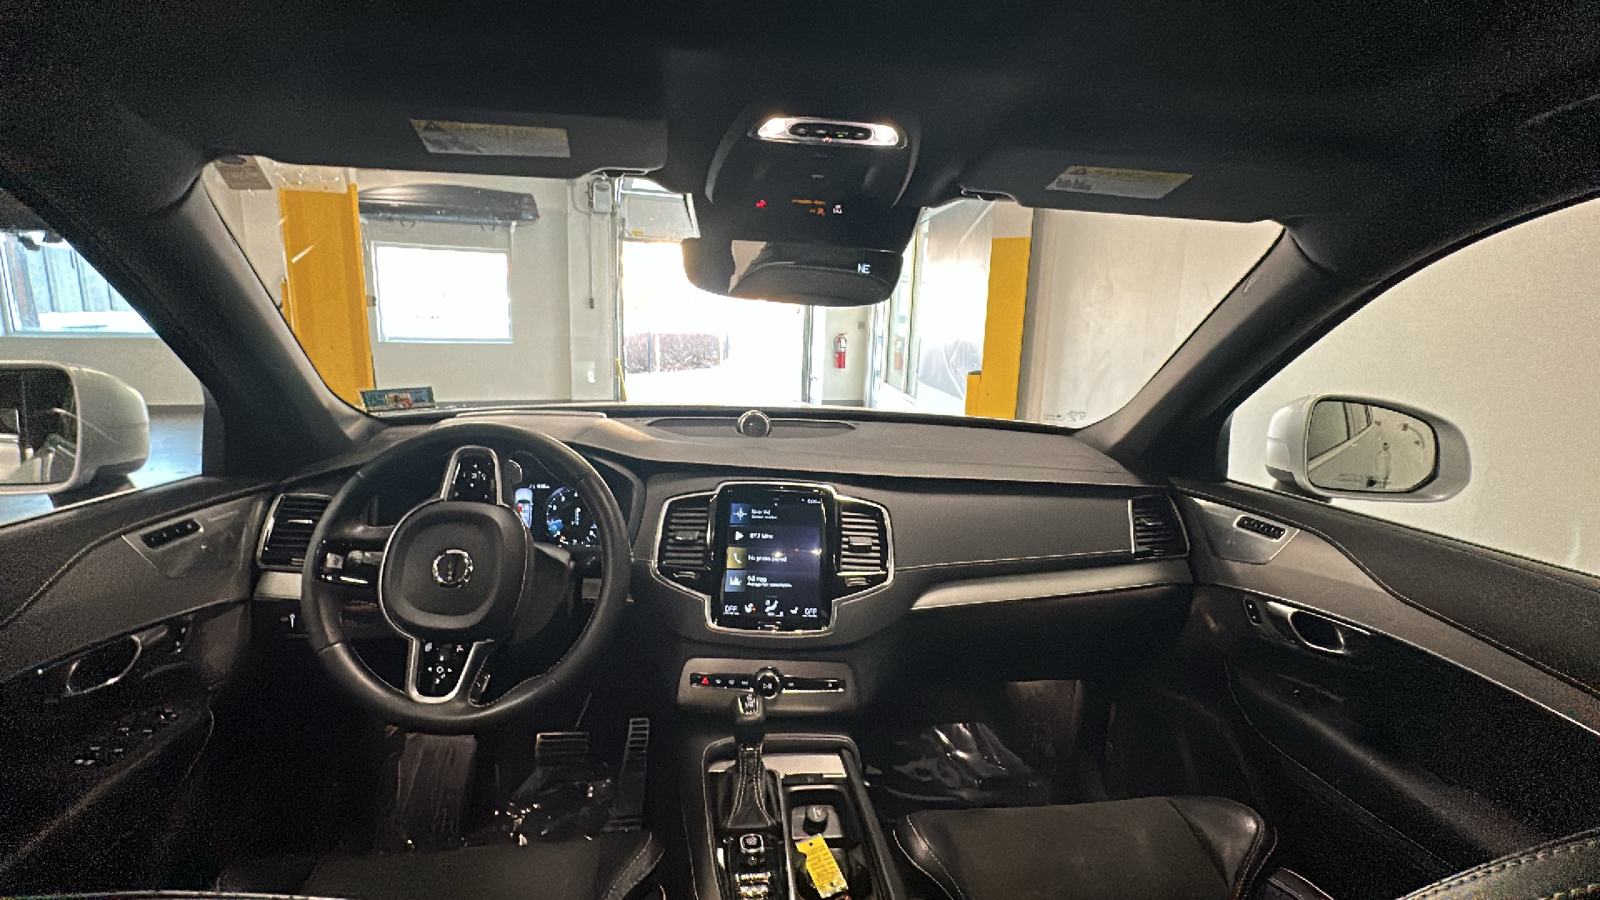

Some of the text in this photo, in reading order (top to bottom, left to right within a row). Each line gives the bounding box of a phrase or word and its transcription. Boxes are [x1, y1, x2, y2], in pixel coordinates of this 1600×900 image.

[857, 263, 871, 274] NE
[724, 604, 738, 613] OFF
[804, 607, 818, 616] OFF
